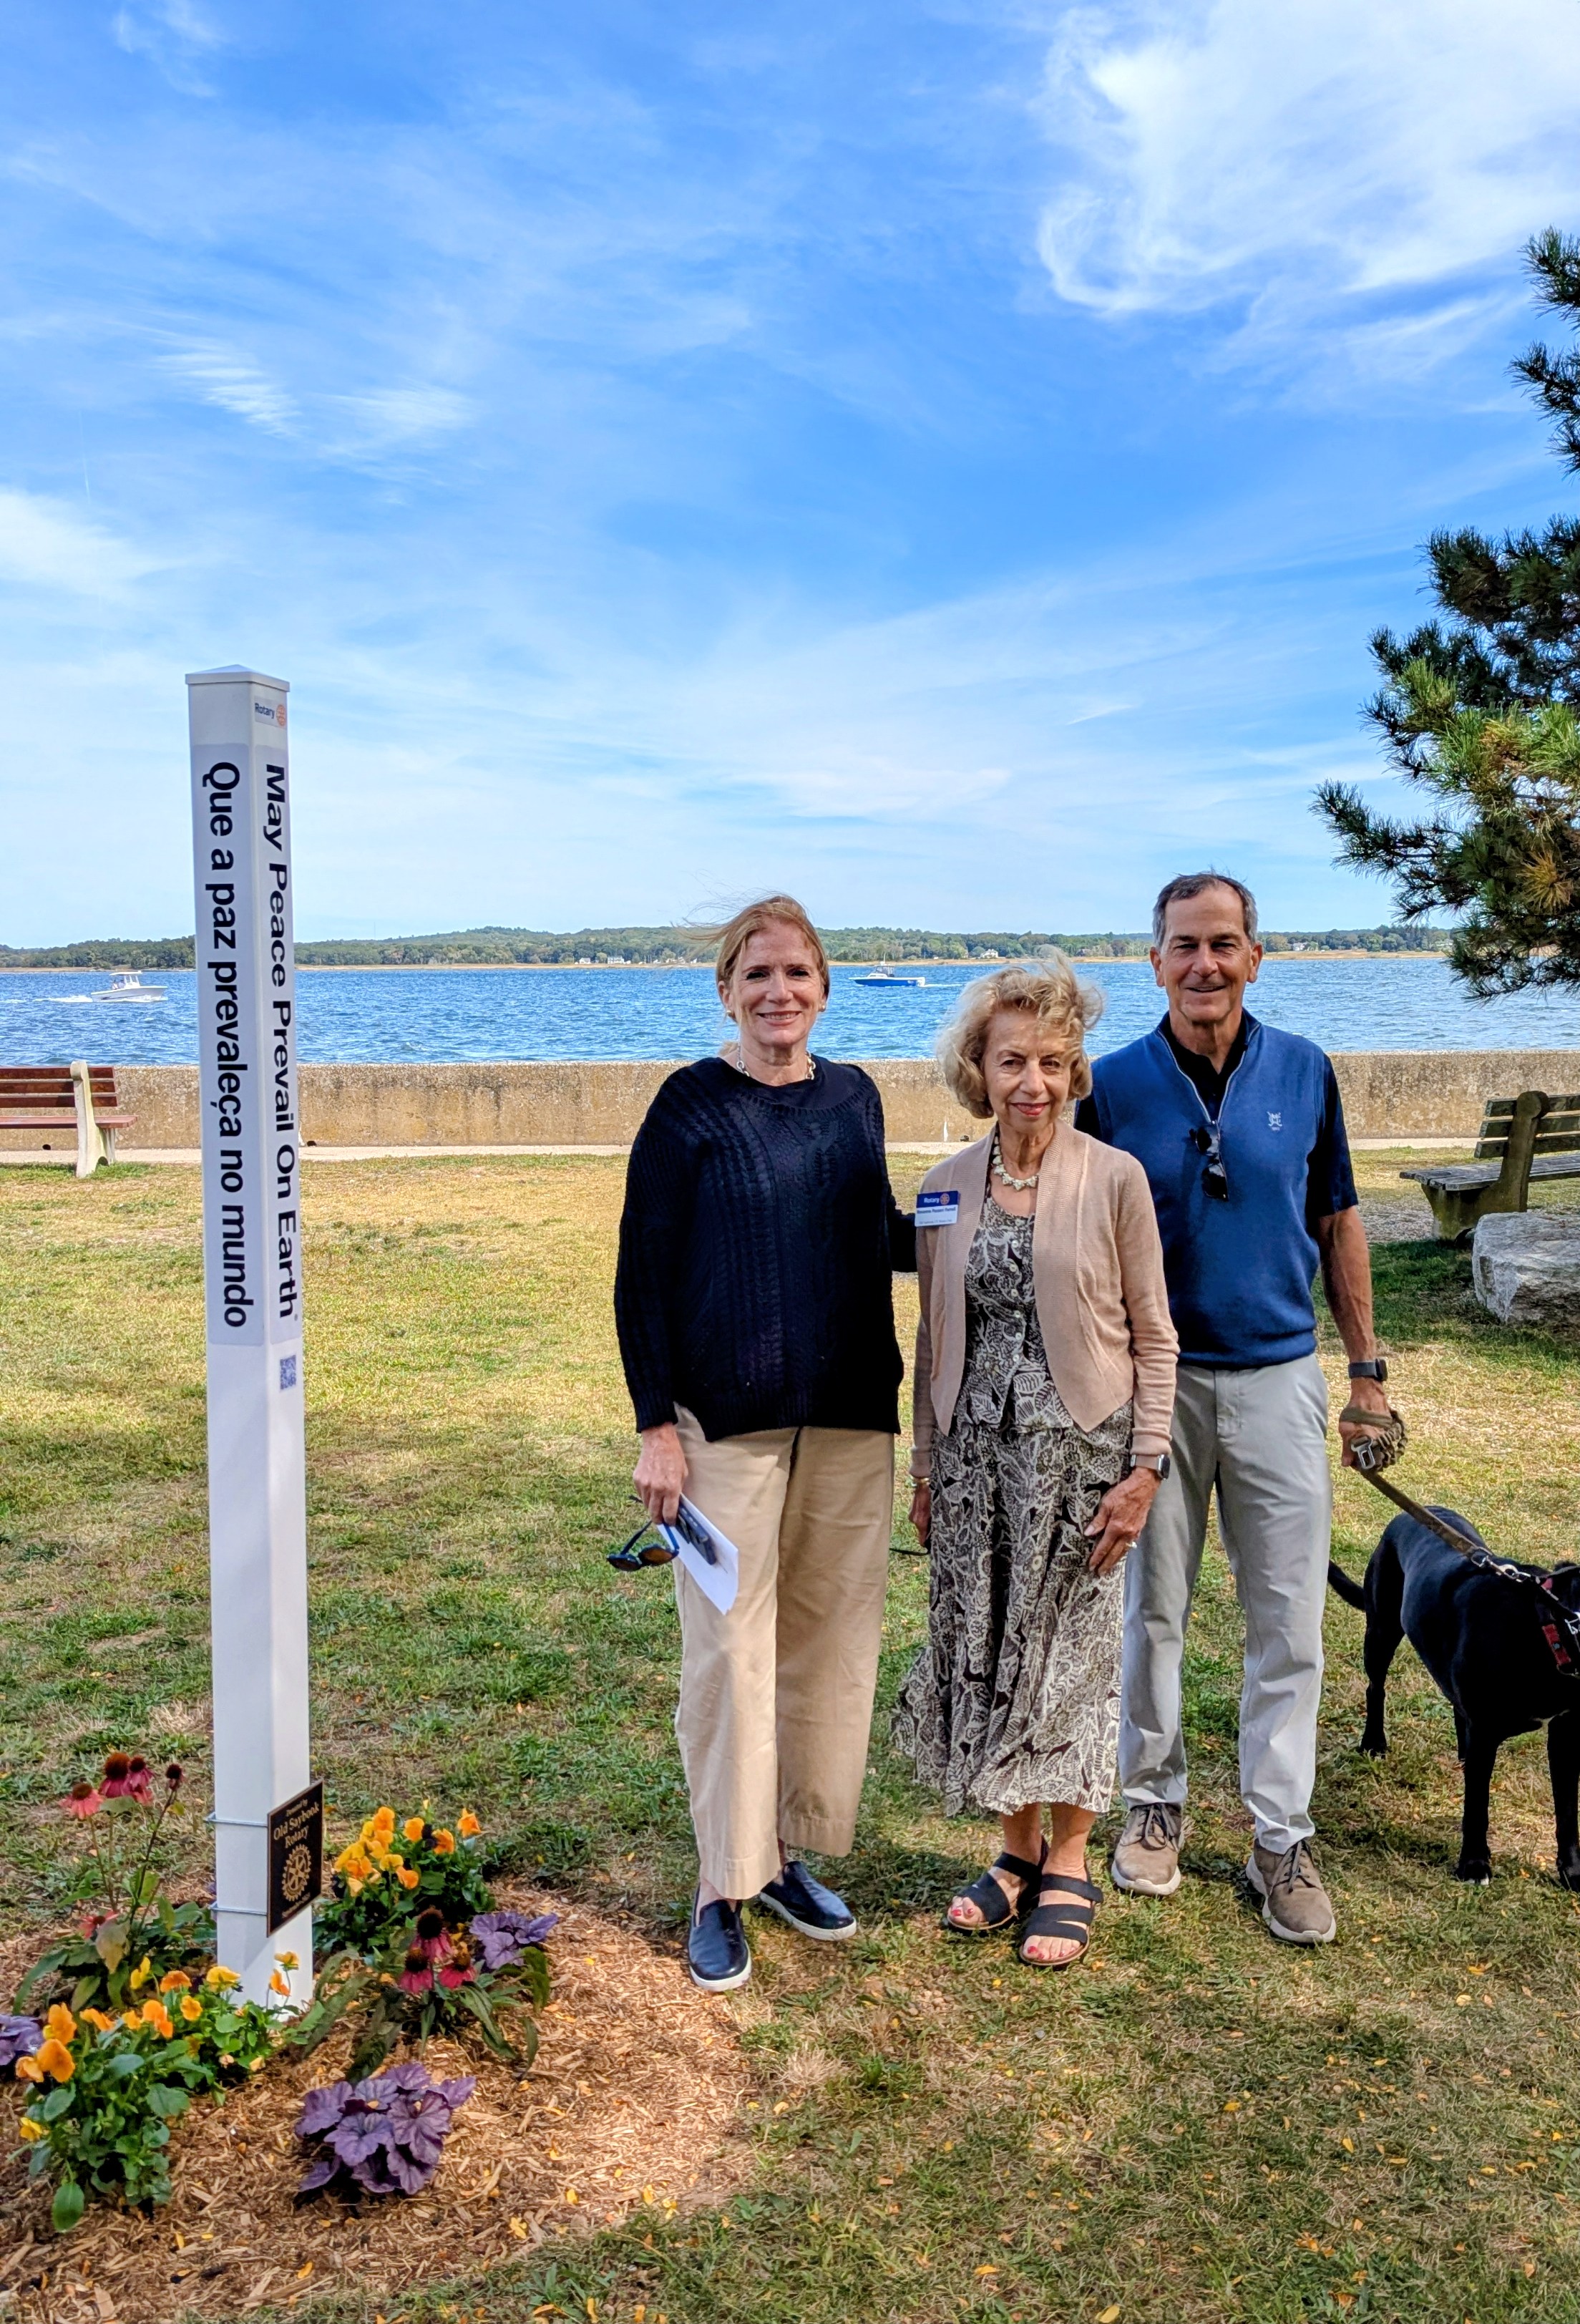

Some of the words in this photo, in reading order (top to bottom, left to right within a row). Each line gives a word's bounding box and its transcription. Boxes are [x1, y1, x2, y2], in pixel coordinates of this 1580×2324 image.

[255, 702, 275, 719] Rotary
[203, 762, 240, 837] Que
[263, 764, 286, 852] May
[210, 848, 234, 871] a
[205, 883, 236, 949] paz
[268, 862, 288, 987] Peace
[207, 961, 248, 1137] prevaleça
[272, 1001, 295, 1132] Prevail
[220, 1149, 244, 1193] no
[276, 1144, 296, 1199] On
[222, 1205, 254, 1328] mundo
[278, 1210, 298, 1318] Earth
[273, 1822, 288, 1840] Old
[286, 1825, 308, 1848] Rotary
